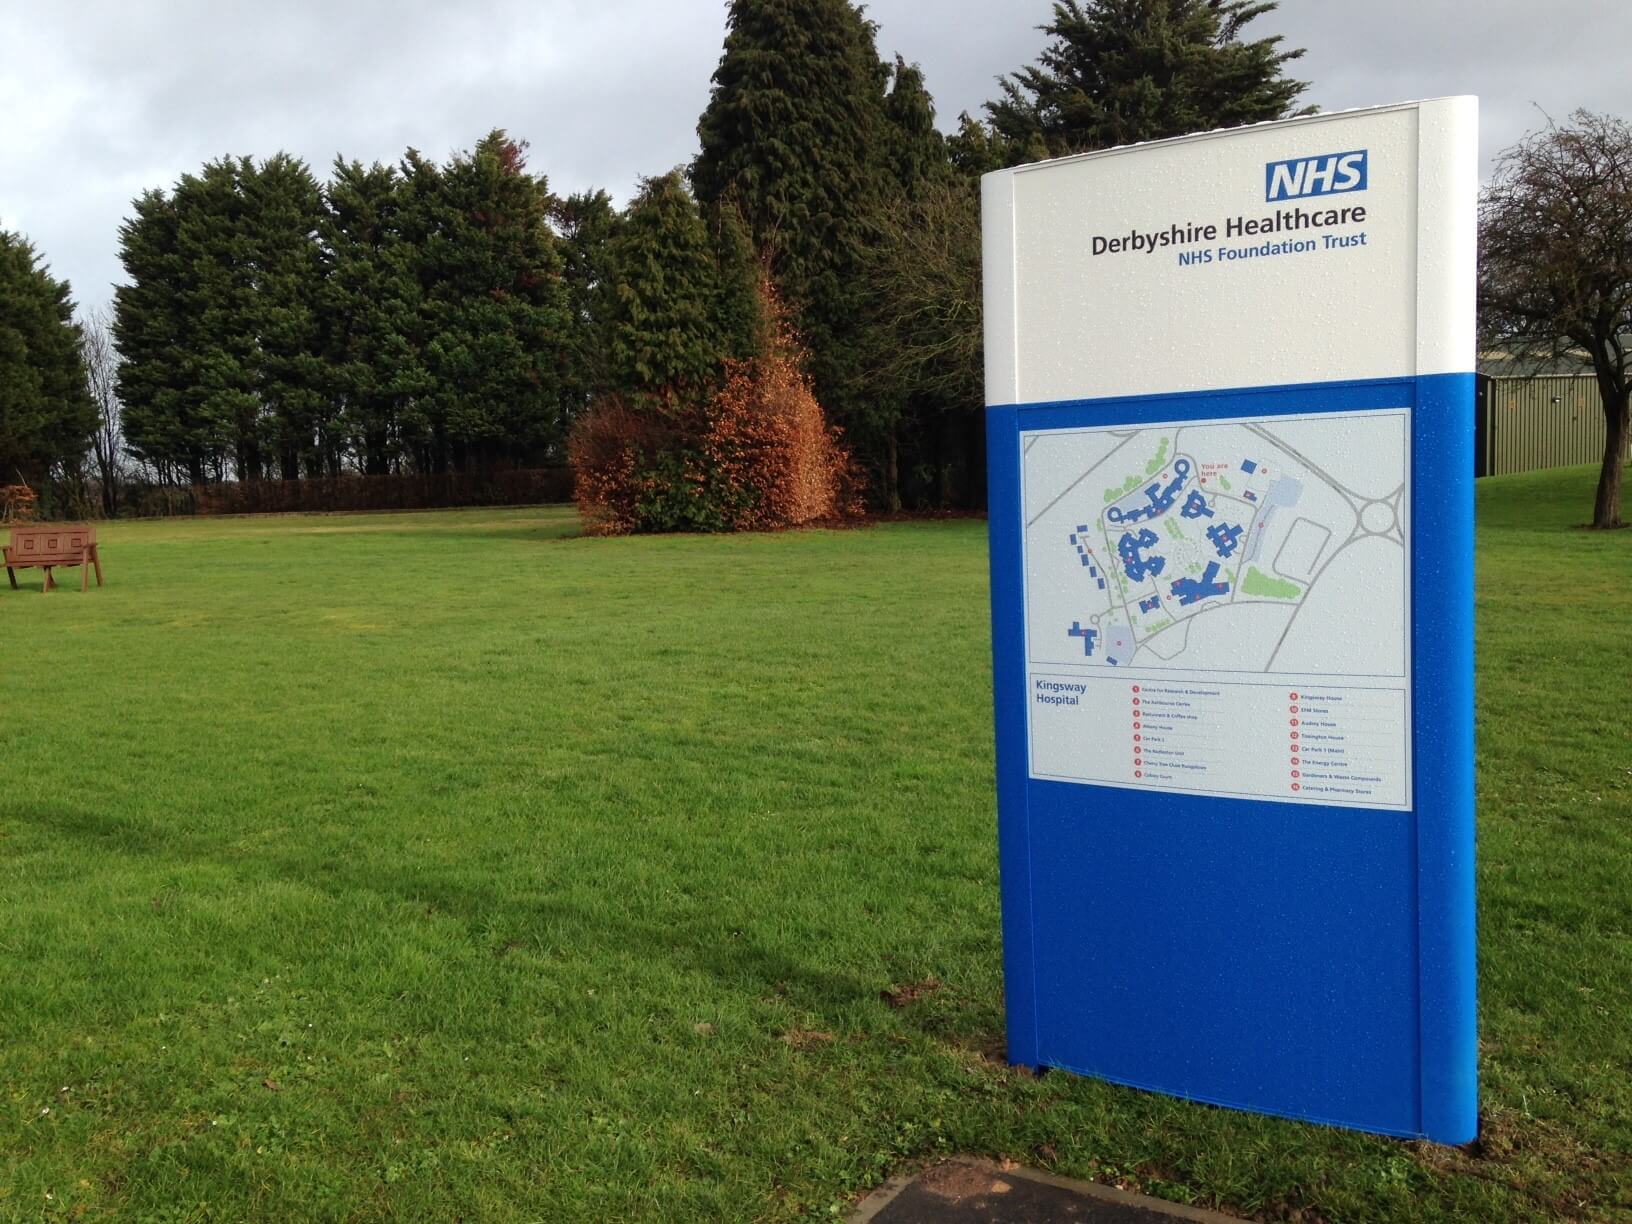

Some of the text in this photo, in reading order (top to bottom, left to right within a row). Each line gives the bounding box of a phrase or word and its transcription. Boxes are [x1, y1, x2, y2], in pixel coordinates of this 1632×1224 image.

[1268, 153, 1363, 199] NHS
[1092, 206, 1367, 256] Derbyshire Healthcare
[1179, 232, 1367, 266] NHS Foundation Trust
[1036, 680, 1087, 694] Kingsway
[1036, 694, 1079, 707] Hospital
